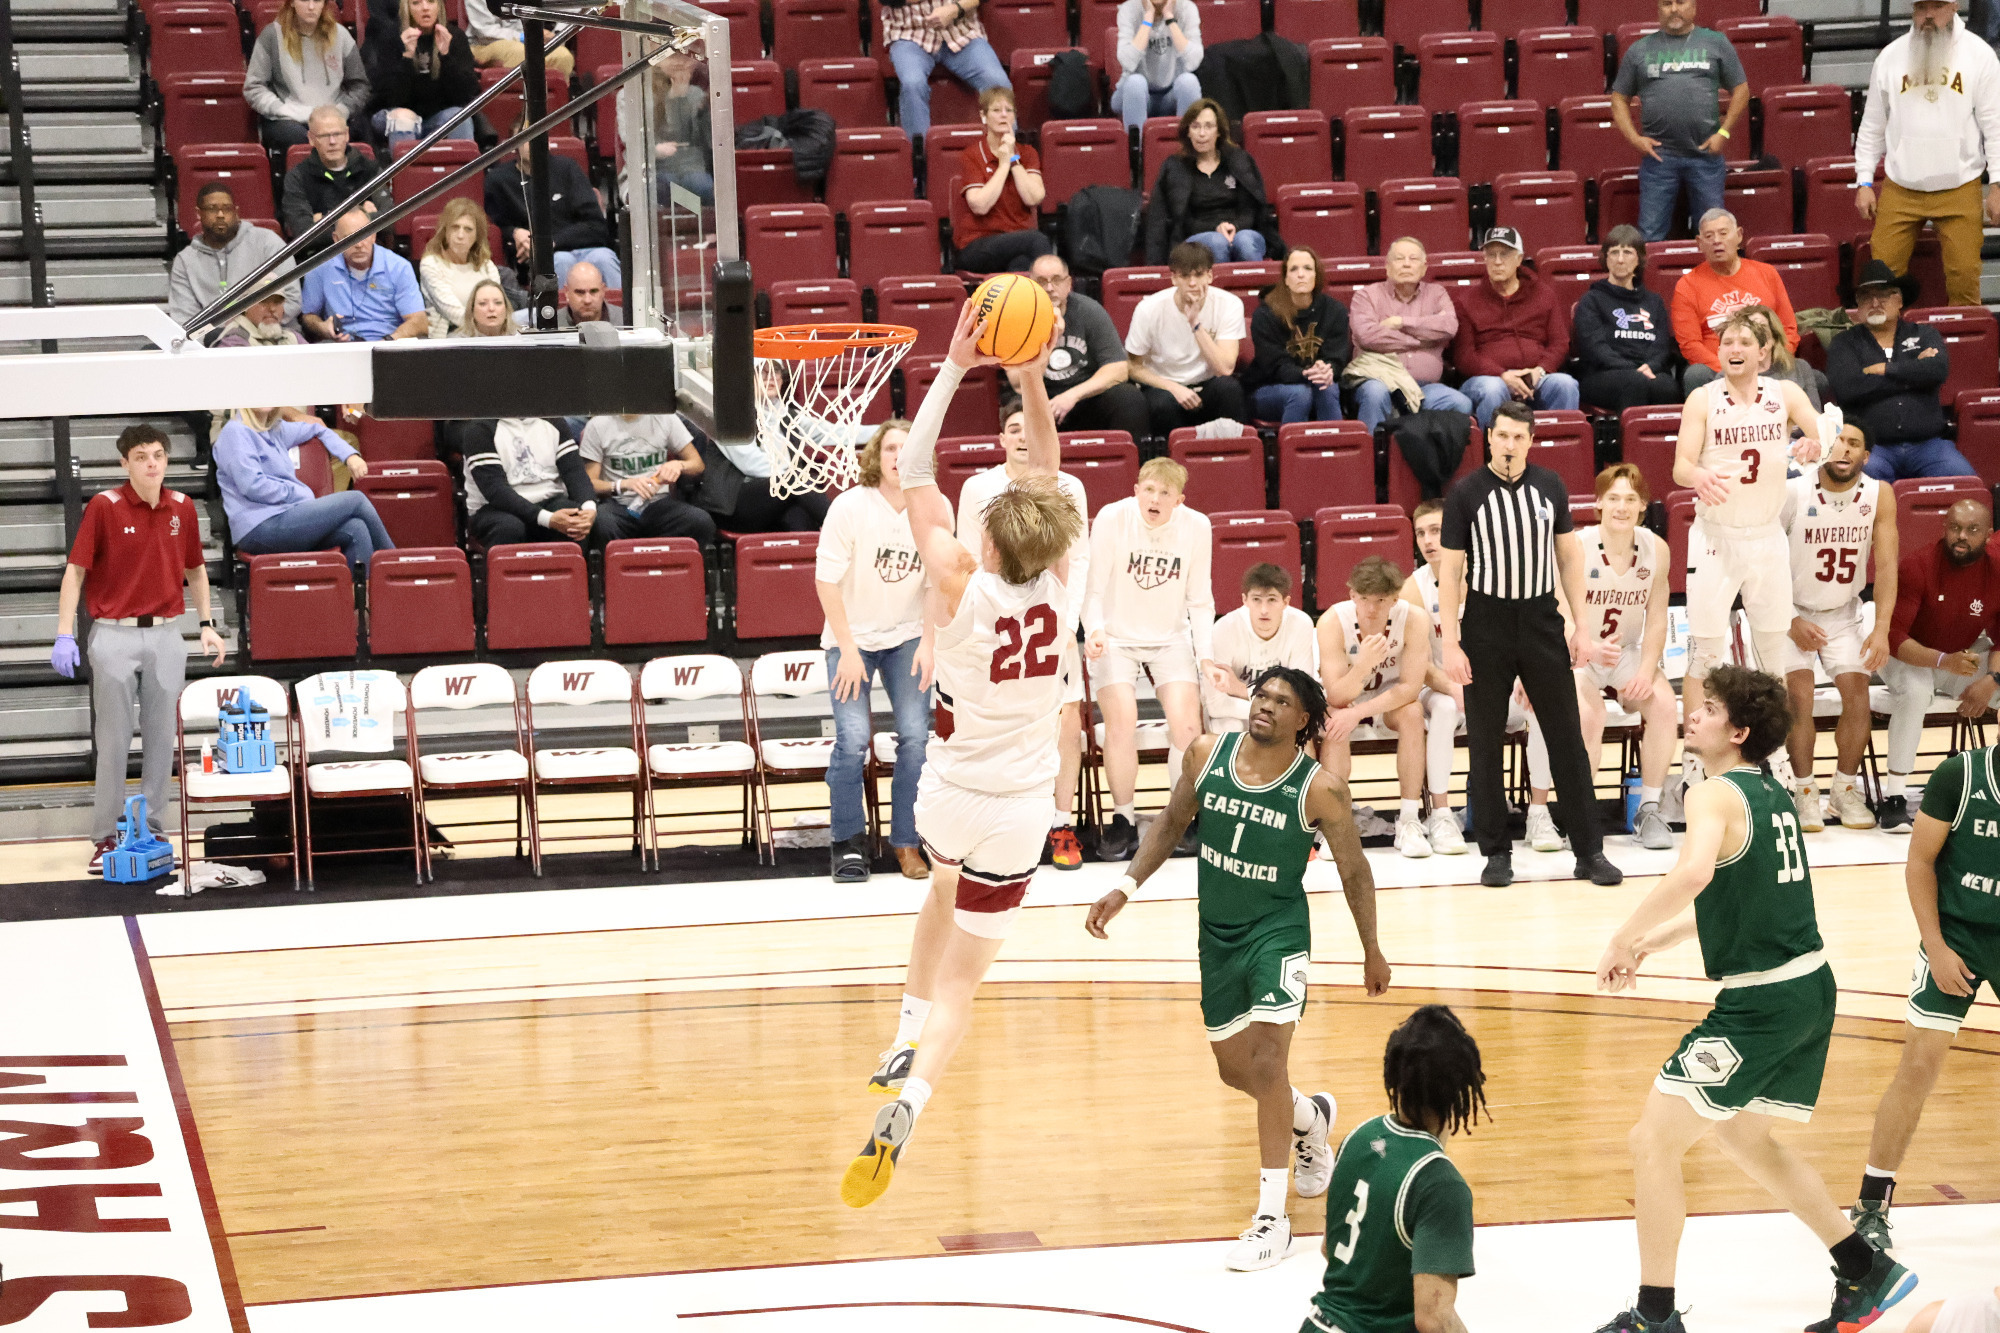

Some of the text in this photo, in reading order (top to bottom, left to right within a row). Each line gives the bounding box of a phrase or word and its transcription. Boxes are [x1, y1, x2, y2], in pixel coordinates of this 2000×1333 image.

[976, 284, 1005, 328] Wils
[1714, 423, 1782, 445] MAVERICKS
[1740, 448, 1760, 484] 3
[1804, 525, 1869, 544] MAVERICKS
[1127, 551, 1181, 580] MESA
[1815, 547, 1858, 584] 35
[1585, 589, 1648, 606] MAVERICKS
[1600, 608, 1622, 639] 5
[990, 603, 1059, 685] 22
[445, 675, 478, 696] WT
[562, 671, 596, 692] WT
[674, 665, 705, 686] WT
[784, 661, 815, 682] WT
[216, 688, 240, 709] W
[1204, 791, 1287, 830] EASTERN
[1230, 822, 1245, 854] 1
[1973, 818, 2000, 838] EA
[1771, 811, 1805, 883] 33
[1201, 842, 1278, 882] NEW MEXICO
[1961, 871, 1994, 894] NEW
[1333, 1178, 1370, 1265] 3
